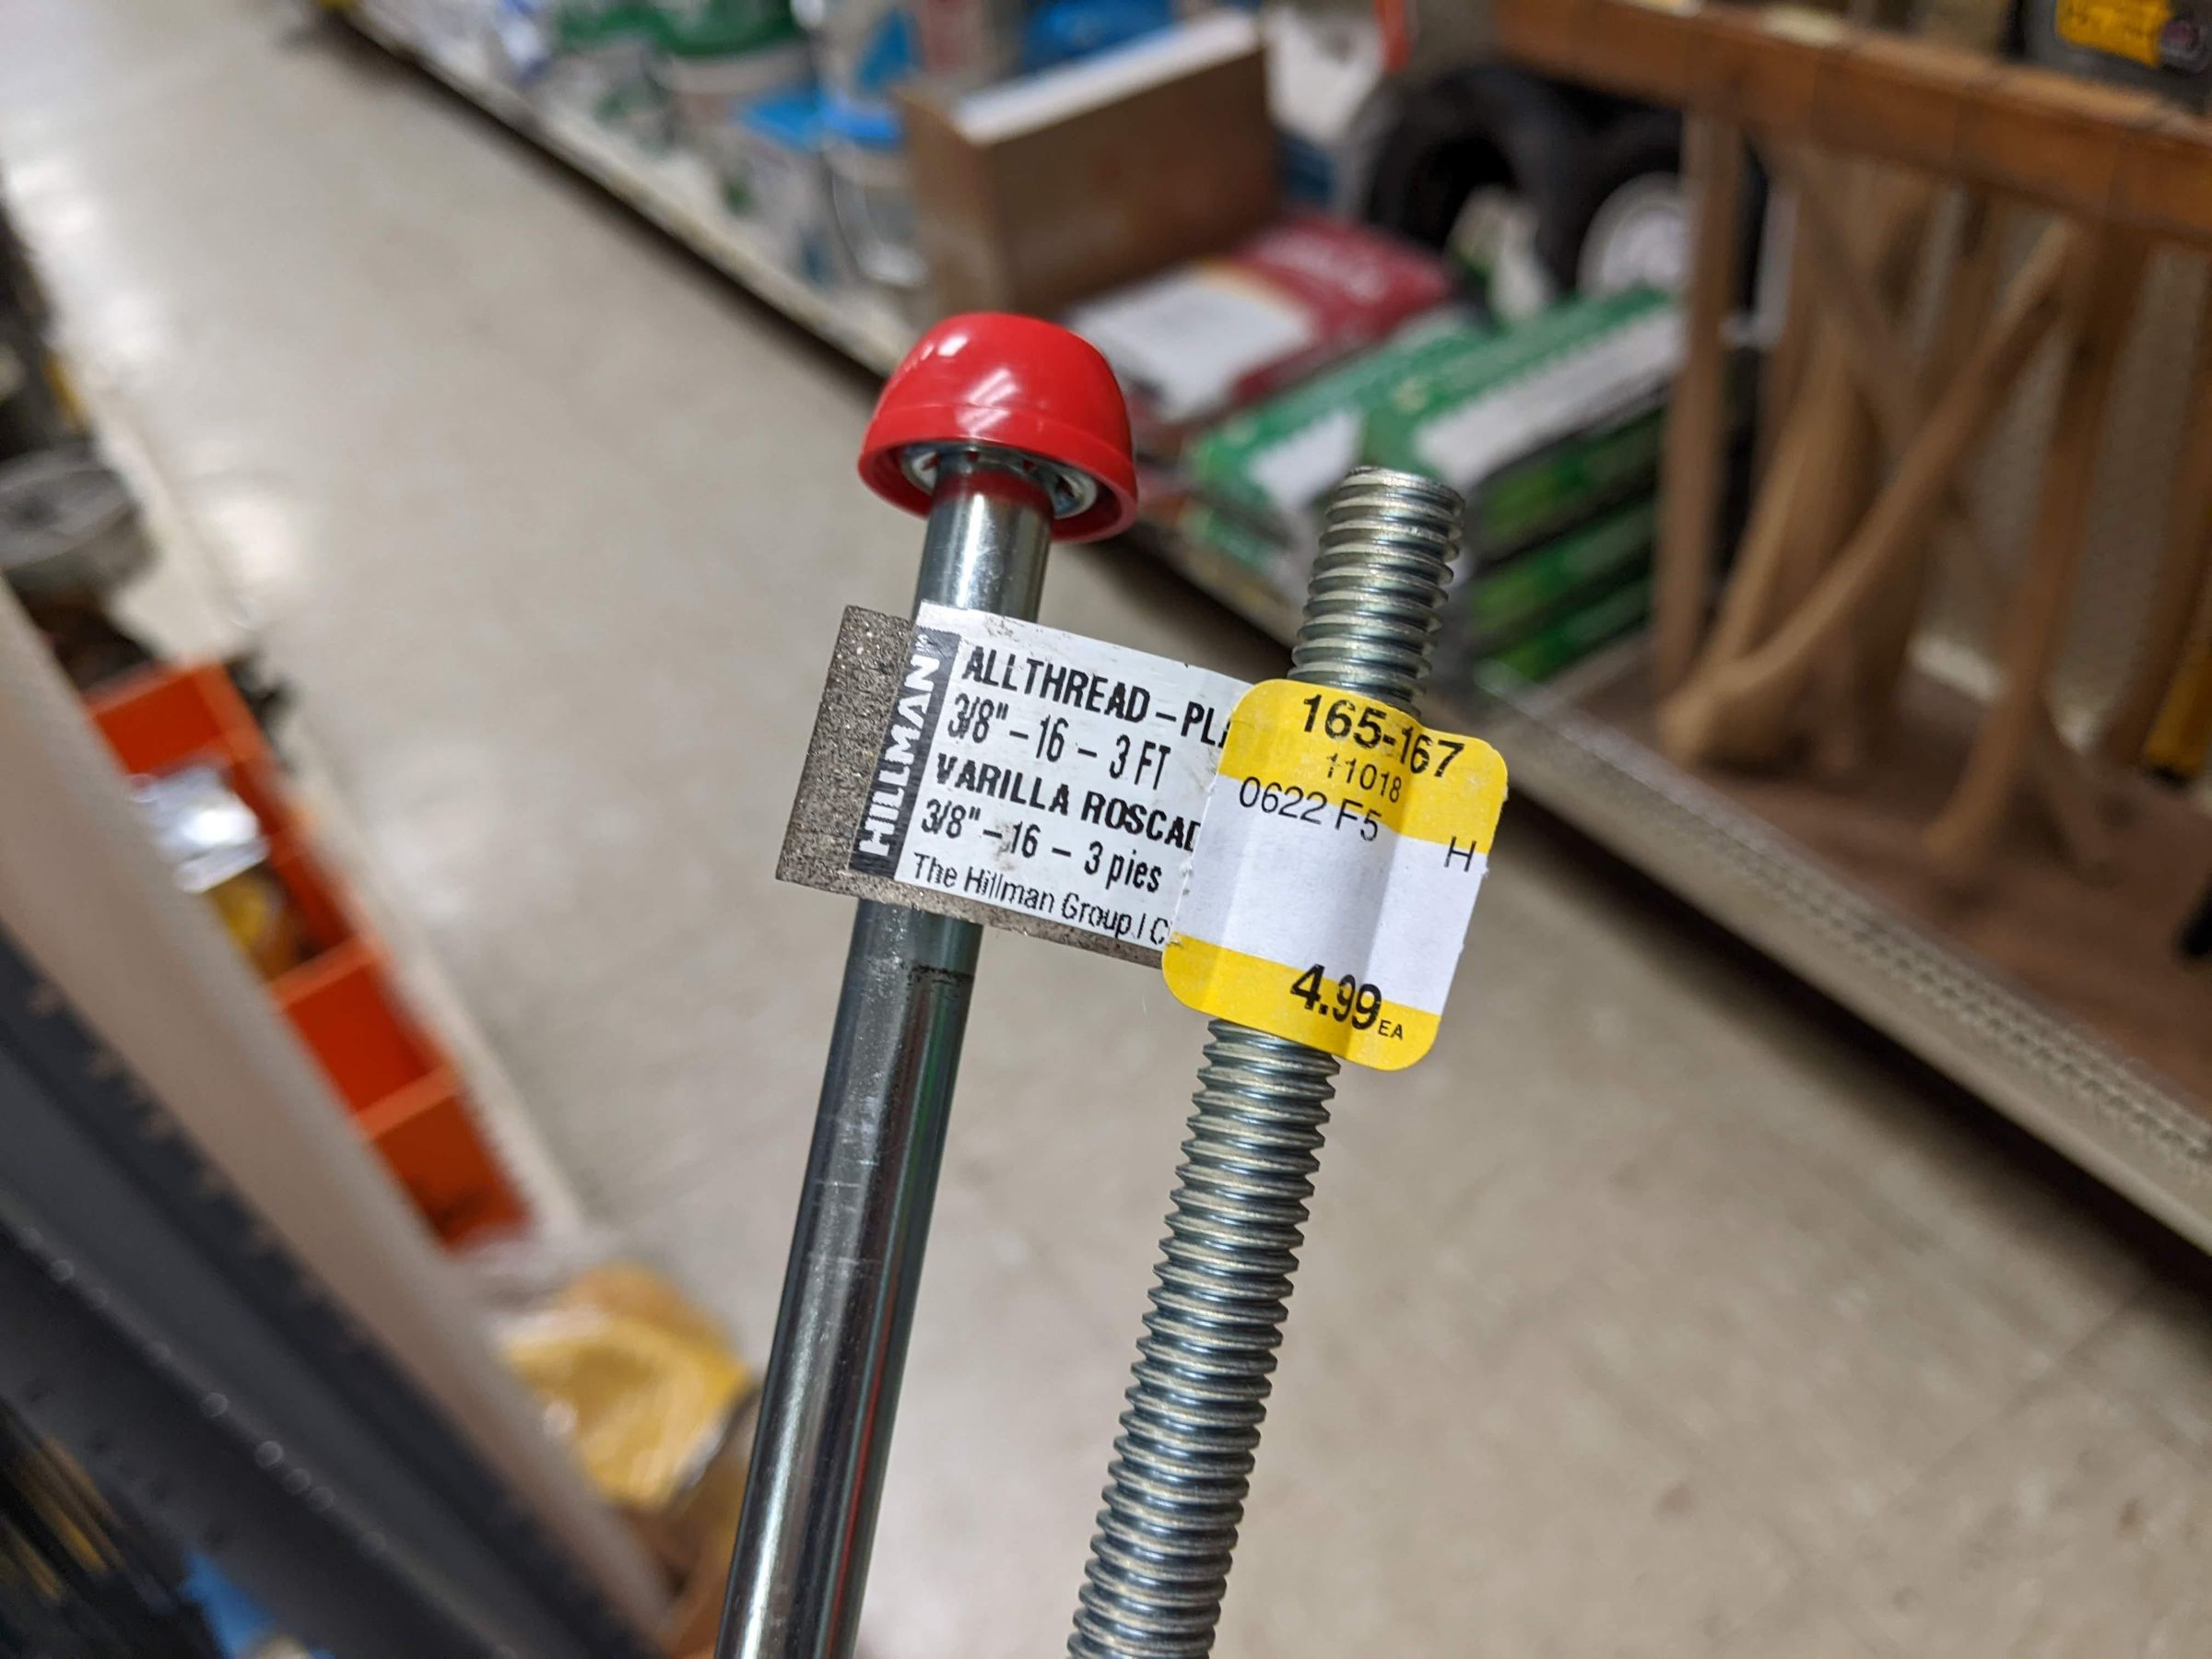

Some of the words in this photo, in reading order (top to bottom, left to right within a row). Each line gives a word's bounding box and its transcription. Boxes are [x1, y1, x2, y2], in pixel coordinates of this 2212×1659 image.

[859, 653, 940, 856] HILLMAN
[1110, 734, 1131, 780] 3
[1134, 740, 1171, 792] FT
[1303, 694, 1465, 778] 165-167
[936, 753, 1069, 816] VARILLA
[1240, 776, 1327, 825] 0622
[1335, 798, 1382, 841] F5
[1327, 753, 1402, 803] 11018
[1084, 841, 1103, 876] 3
[1105, 849, 1162, 893] pies
[1444, 836, 1477, 872] H
[913, 852, 958, 888] The
[963, 866, 1055, 913] Hillman
[1061, 892, 1133, 939] Group
[1290, 964, 1382, 1030] 4.99
[1378, 1019, 1404, 1041] EA
